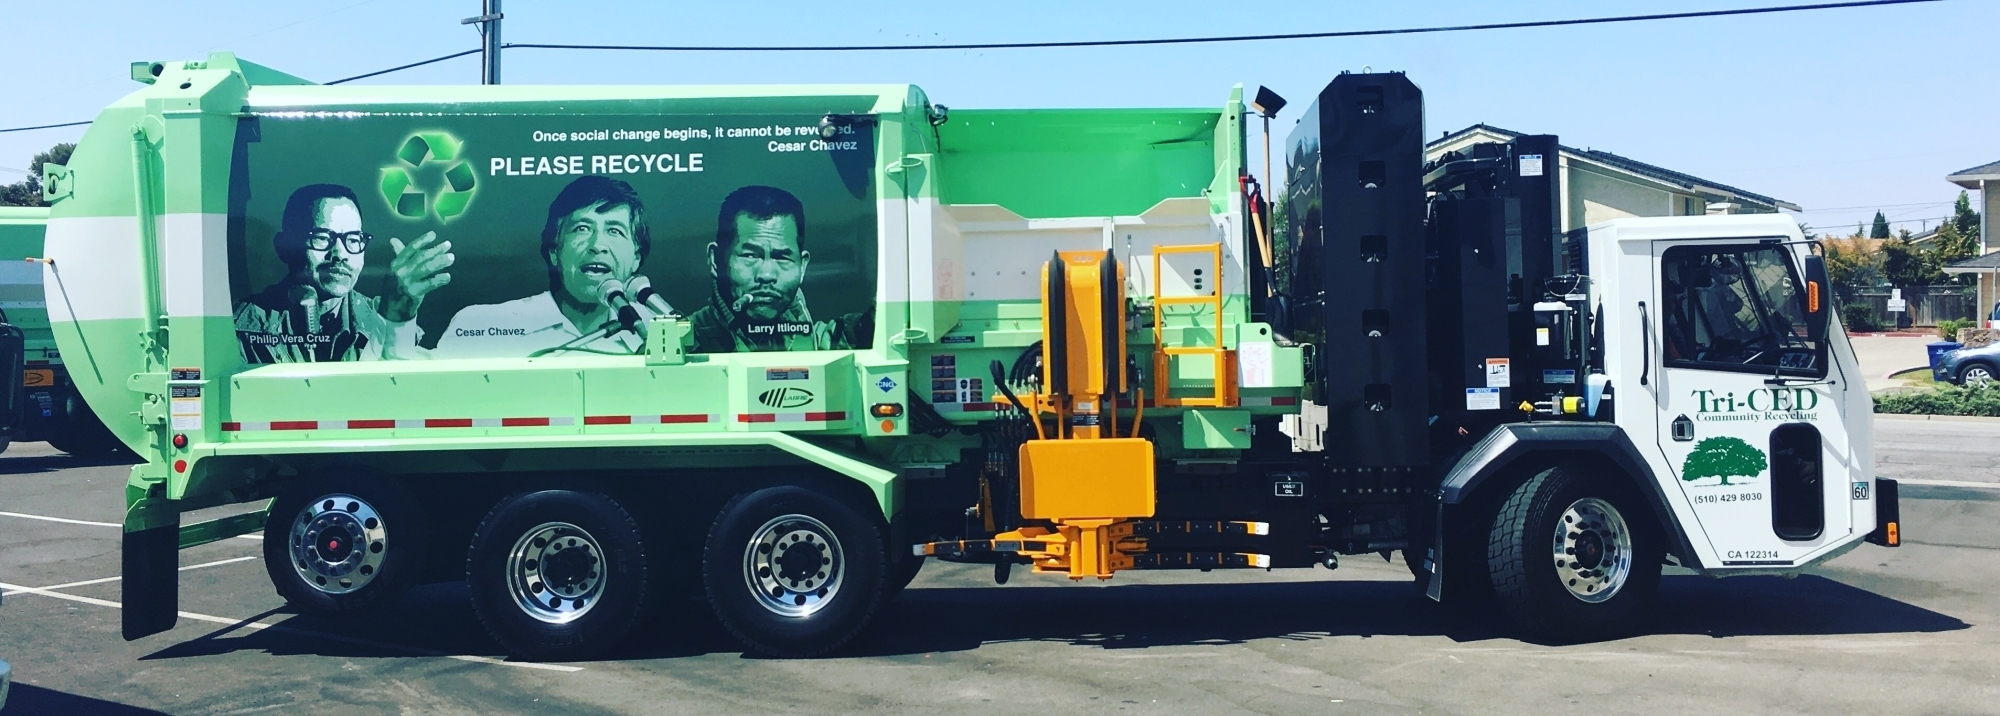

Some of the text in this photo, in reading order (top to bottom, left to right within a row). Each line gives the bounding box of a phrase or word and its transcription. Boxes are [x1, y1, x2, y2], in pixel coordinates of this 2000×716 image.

[533, 130, 567, 142] Once
[570, 129, 609, 141] social
[612, 128, 661, 142] change
[664, 126, 712, 142] begins,
[715, 126, 724, 138] it
[727, 125, 772, 138] cannot
[775, 125, 791, 137] be
[768, 139, 858, 152] Cesar Chavez
[490, 153, 704, 176] PLEASE RECYCLE
[455, 327, 526, 337] Cesar Chavez
[748, 322, 810, 335] Larry Itliong
[249, 333, 331, 346] Philip Vera Cruz
[1690, 387, 1818, 412] Tri-CED
[1696, 410, 1818, 423] Community Recycling
[1694, 492, 1762, 504] (510) 429 8030
[1854, 486, 1867, 499] 60
[1727, 550, 1779, 559] CA 122314
